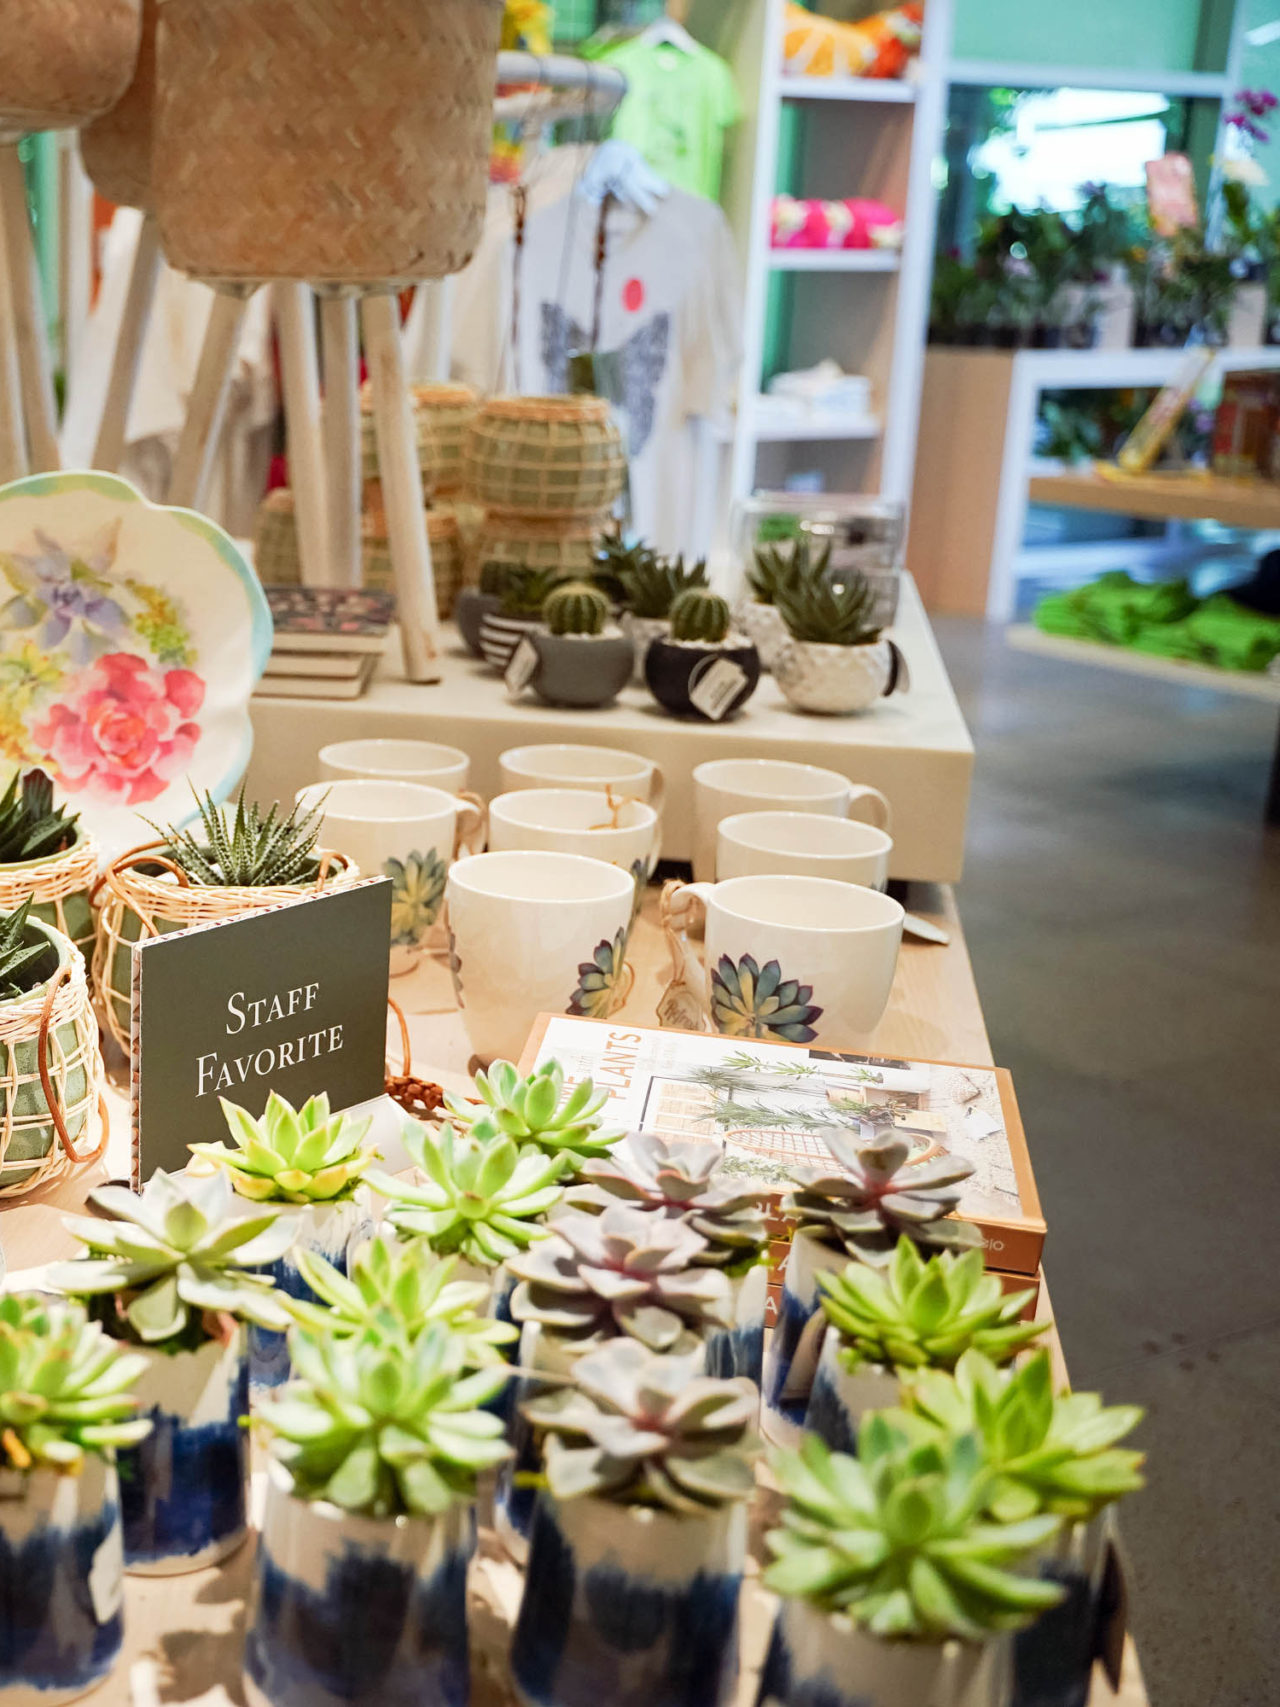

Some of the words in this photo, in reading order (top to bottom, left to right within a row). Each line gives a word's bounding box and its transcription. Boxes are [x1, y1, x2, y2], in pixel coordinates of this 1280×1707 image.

[226, 982, 320, 1034] STAFF
[195, 1025, 344, 1097] FAVORITE
[595, 1032, 642, 1099] PLANTS
